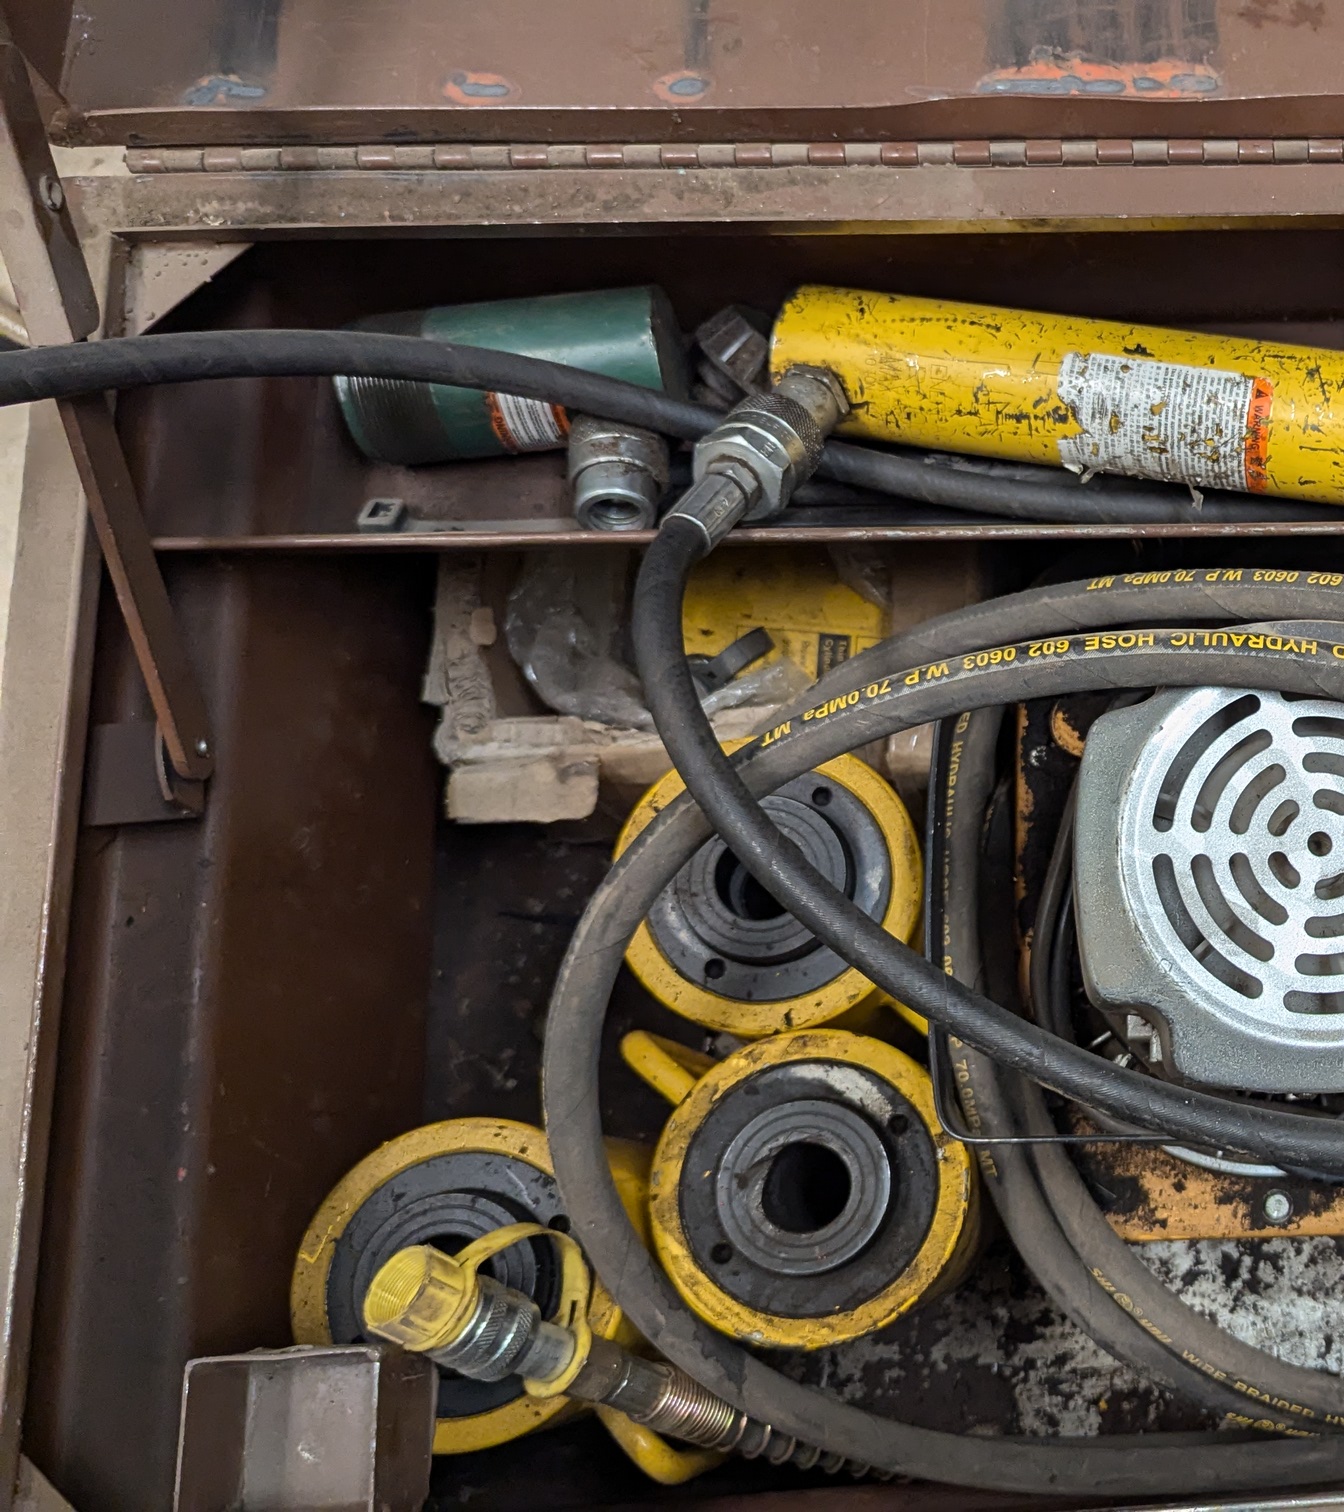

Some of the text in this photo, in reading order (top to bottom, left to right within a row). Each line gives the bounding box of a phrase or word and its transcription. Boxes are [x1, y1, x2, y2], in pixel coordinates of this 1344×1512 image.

[1251, 404, 1262, 450] WARNING
[1086, 575, 1115, 591] MT
[1124, 569, 1196, 585] 70.0MPa
[1206, 568, 1243, 582] W.P
[1253, 570, 1299, 583] 0603
[1307, 571, 1342, 586] 602
[1028, 639, 1071, 658] 602
[1084, 634, 1155, 651] HOSE
[1170, 632, 1318, 656] HYDRAULIC
[963, 647, 1017, 670] 0603
[904, 661, 950, 687] W.P
[803, 687, 892, 722] 70.0MPa
[761, 720, 792, 748] MT
[979, 1146, 998, 1179] MT
